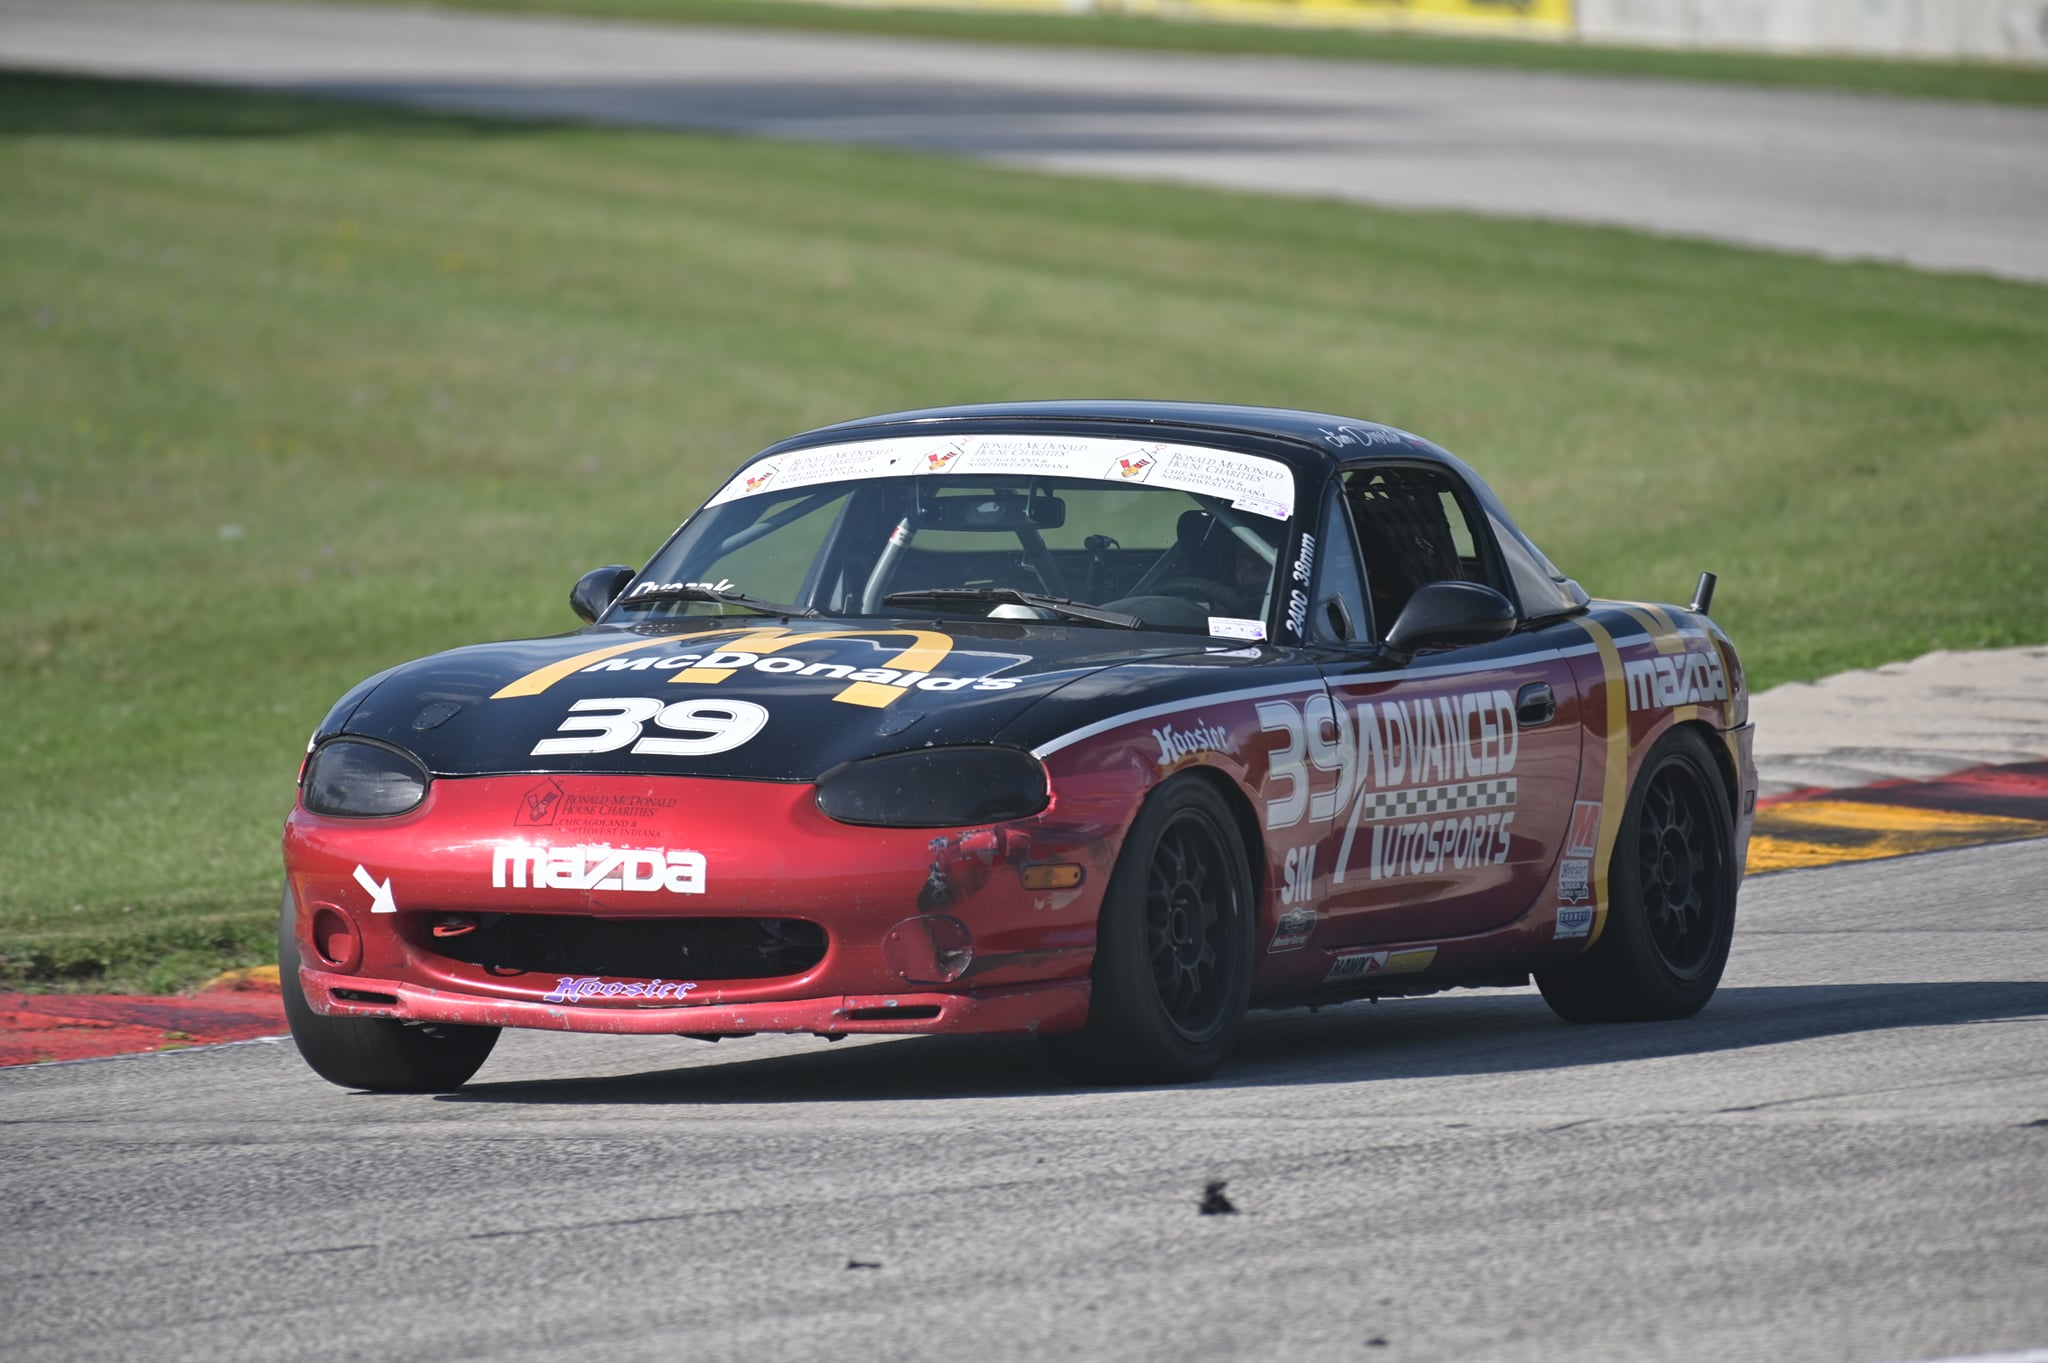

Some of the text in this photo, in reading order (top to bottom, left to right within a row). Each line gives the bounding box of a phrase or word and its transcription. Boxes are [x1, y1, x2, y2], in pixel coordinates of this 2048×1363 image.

[1167, 458, 1204, 472] HOUSE
[1171, 452, 1216, 465] RONALD
[1161, 473, 1267, 498] NORTHWEST INDIANA
[1163, 468, 1235, 485] CHICAGOLAND
[1286, 532, 1316, 639] 2400 38mm
[581, 651, 1023, 692] McDonald's
[530, 697, 769, 757] 39
[1353, 689, 1519, 789] ADVANCED
[1152, 718, 1228, 766] Hoosier
[1255, 692, 1358, 832] 39
[562, 805, 658, 817] HOUSE CHARITIES
[566, 794, 609, 806] RONALD
[559, 819, 629, 828] CHICAGOLAND
[620, 828, 662, 838] INDIANA
[1281, 844, 1317, 905] SM
[543, 976, 698, 1003] Hoosier
